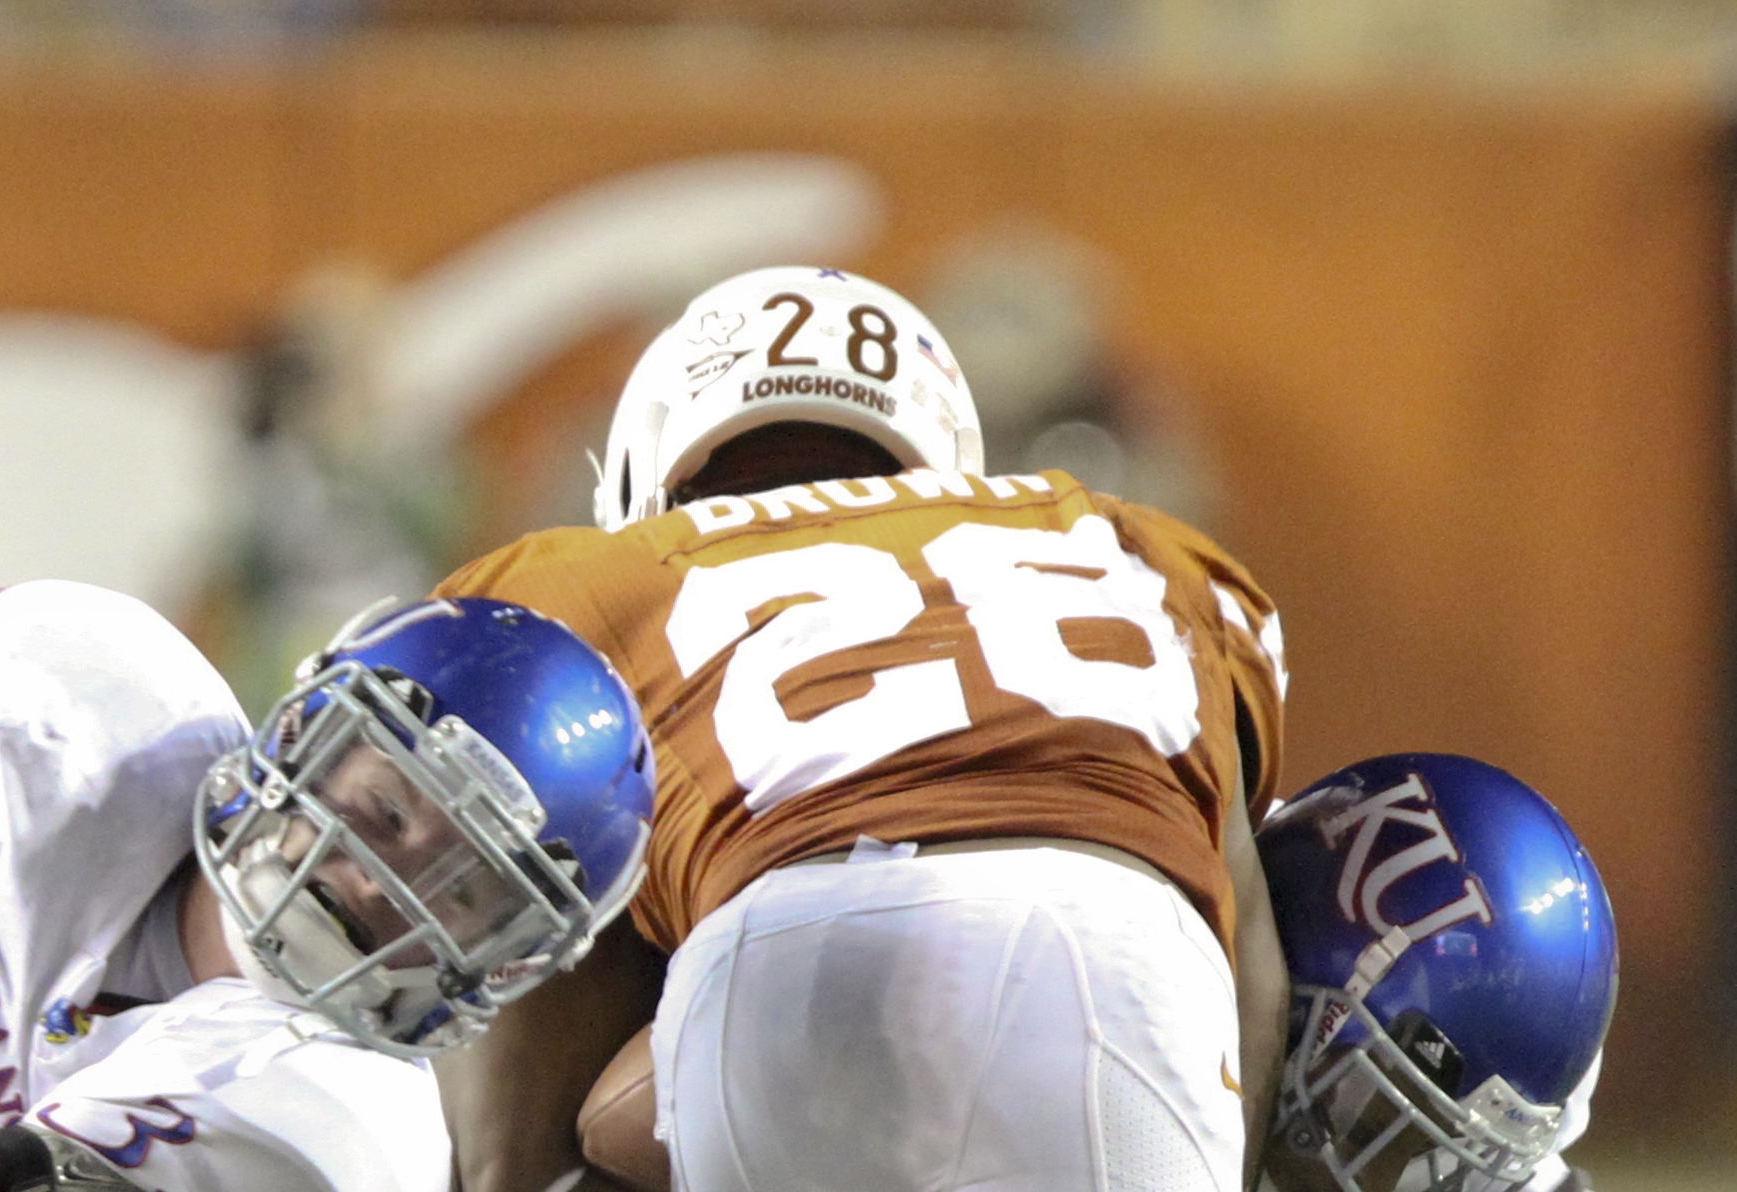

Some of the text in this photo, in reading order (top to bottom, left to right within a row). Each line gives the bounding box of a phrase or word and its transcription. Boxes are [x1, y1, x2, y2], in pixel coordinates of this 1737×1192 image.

[742, 374, 898, 418] LONGHORNS
[762, 292, 898, 382] 28
[665, 514, 1200, 812] 28
[1319, 772, 1495, 943] KU
